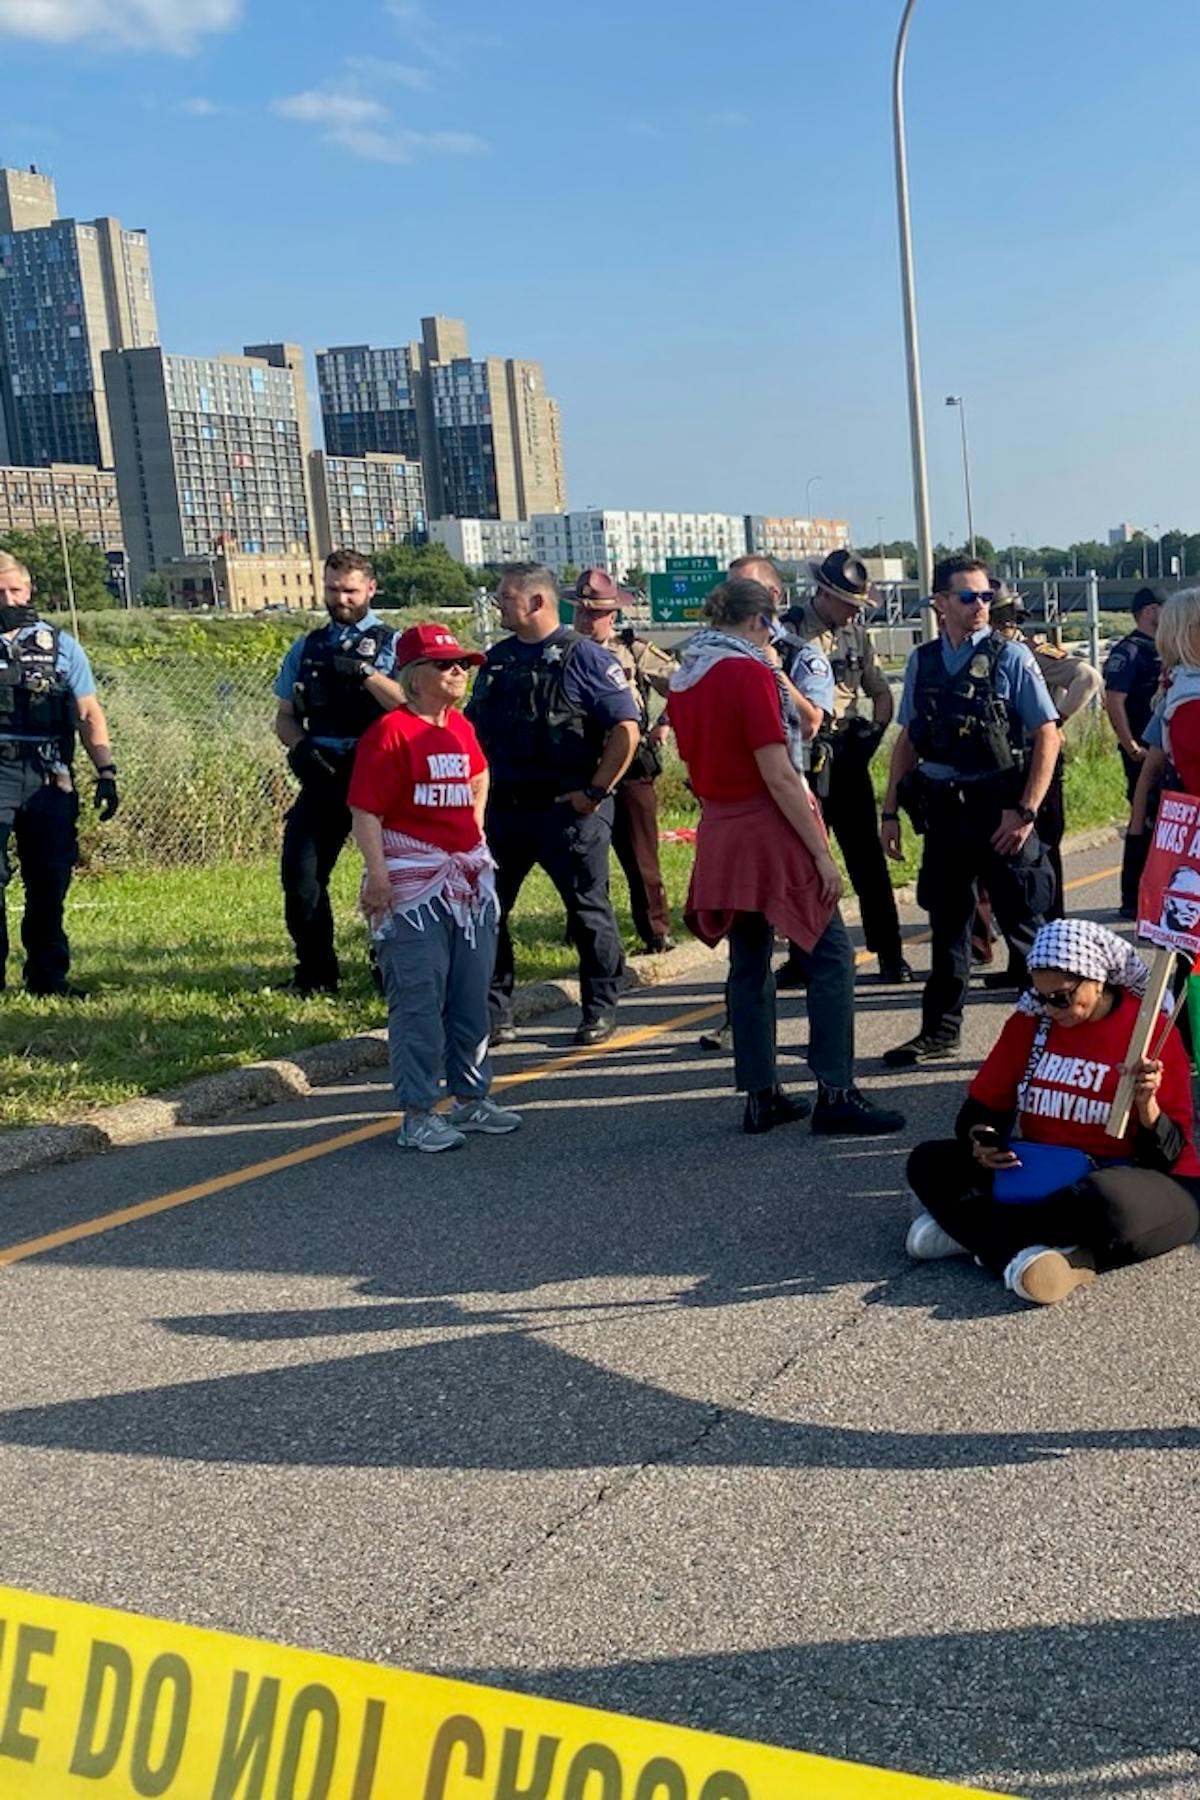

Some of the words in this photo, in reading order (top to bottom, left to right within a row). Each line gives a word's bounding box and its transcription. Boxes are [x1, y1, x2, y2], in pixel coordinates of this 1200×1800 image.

[691, 574, 713, 582] EAST
[1155, 820, 1188, 854] WAS
[1033, 1051, 1111, 1092] ARREST
